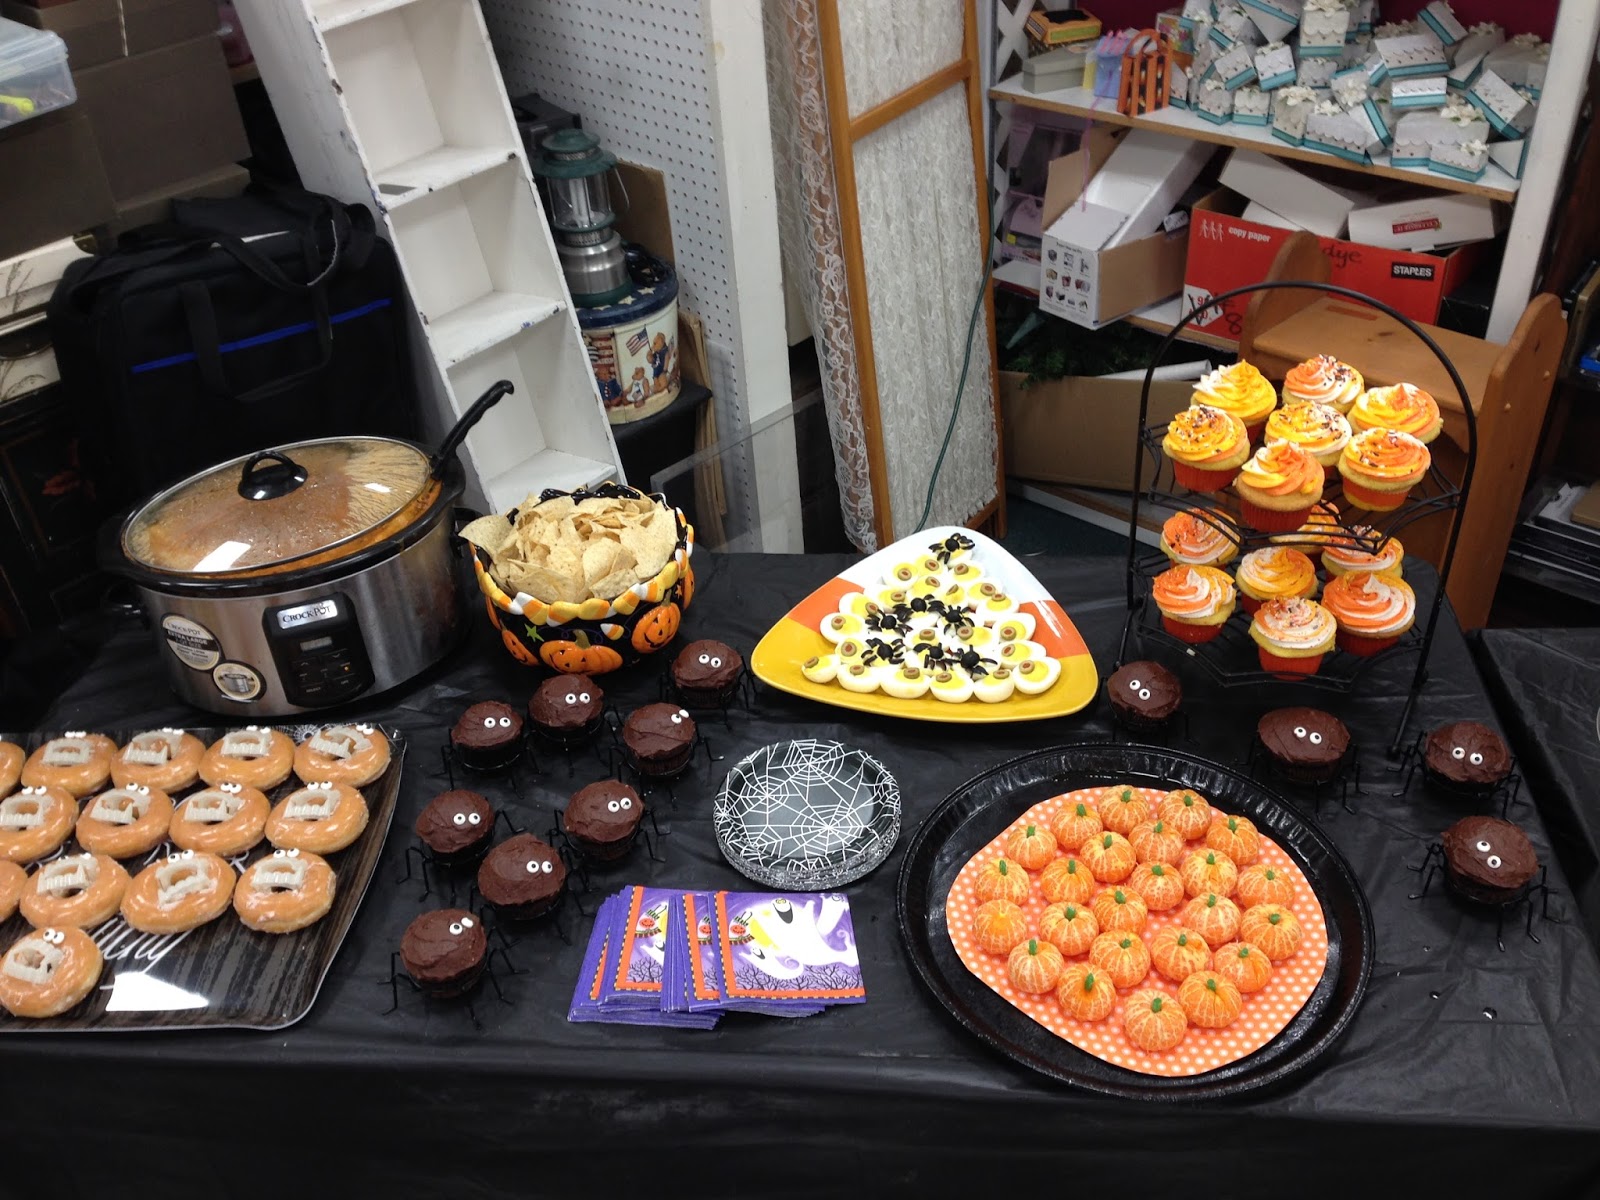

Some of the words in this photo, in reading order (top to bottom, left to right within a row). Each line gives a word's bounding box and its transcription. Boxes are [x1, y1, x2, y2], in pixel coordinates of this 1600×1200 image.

[1228, 226, 1247, 239] copy
[1247, 231, 1271, 243] paper
[1392, 264, 1432, 278] STAPLES
